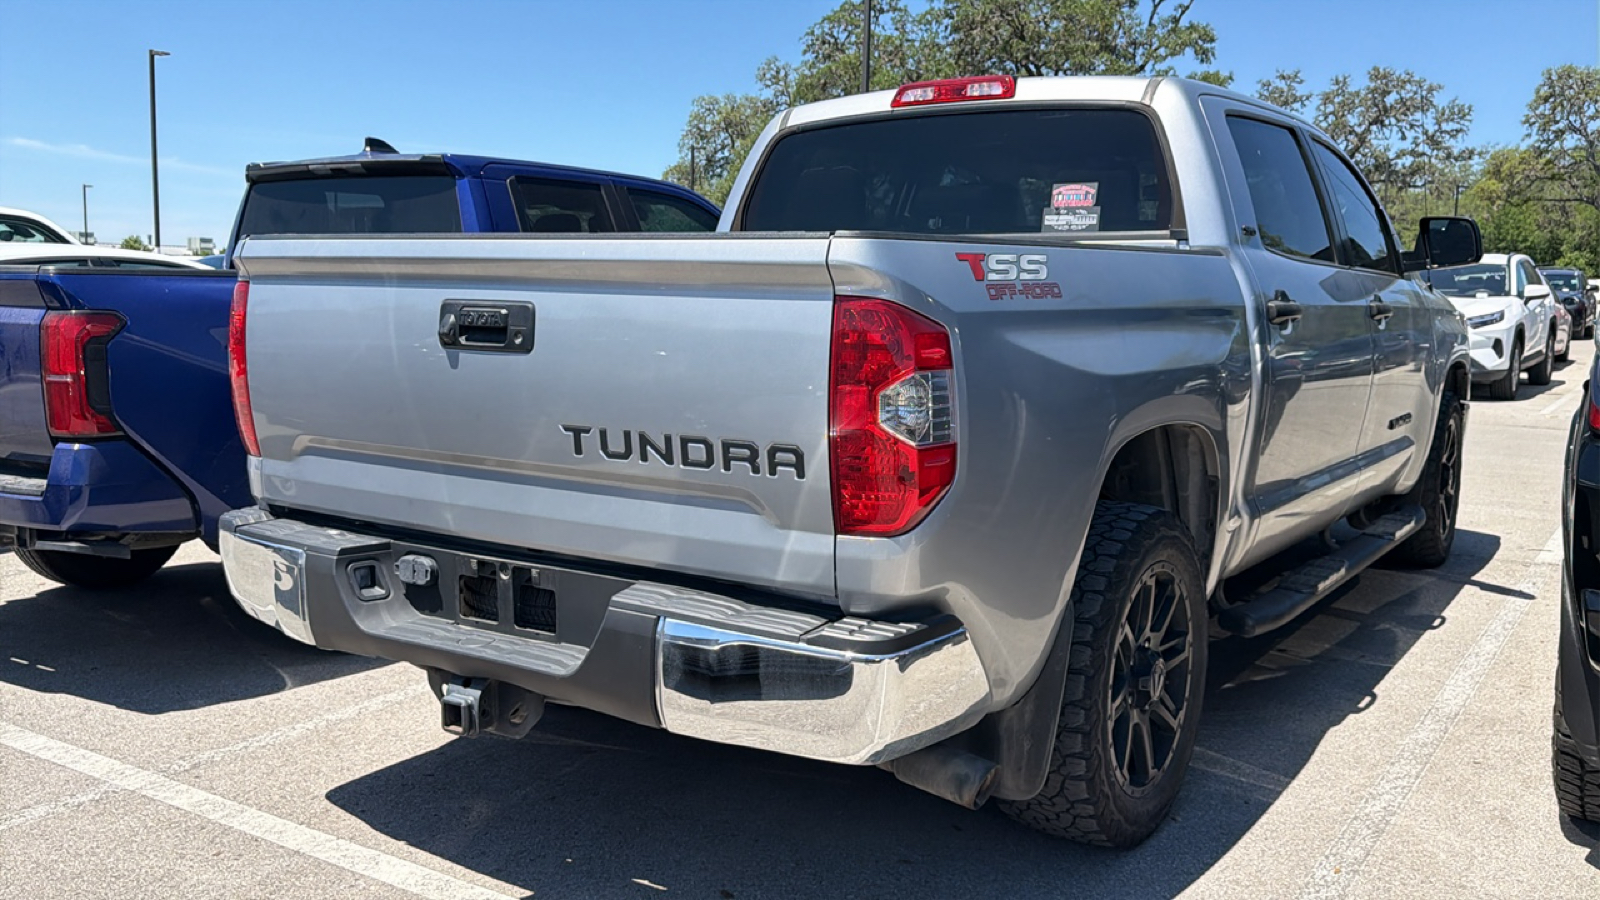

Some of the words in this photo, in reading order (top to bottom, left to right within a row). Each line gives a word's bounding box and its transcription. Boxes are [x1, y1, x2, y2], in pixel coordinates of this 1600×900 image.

[955, 252, 1048, 281] TSS
[985, 282, 1063, 300] OFF-ROAD
[460, 311, 502, 326] TOYOTA
[558, 423, 806, 480] TUNDRA
